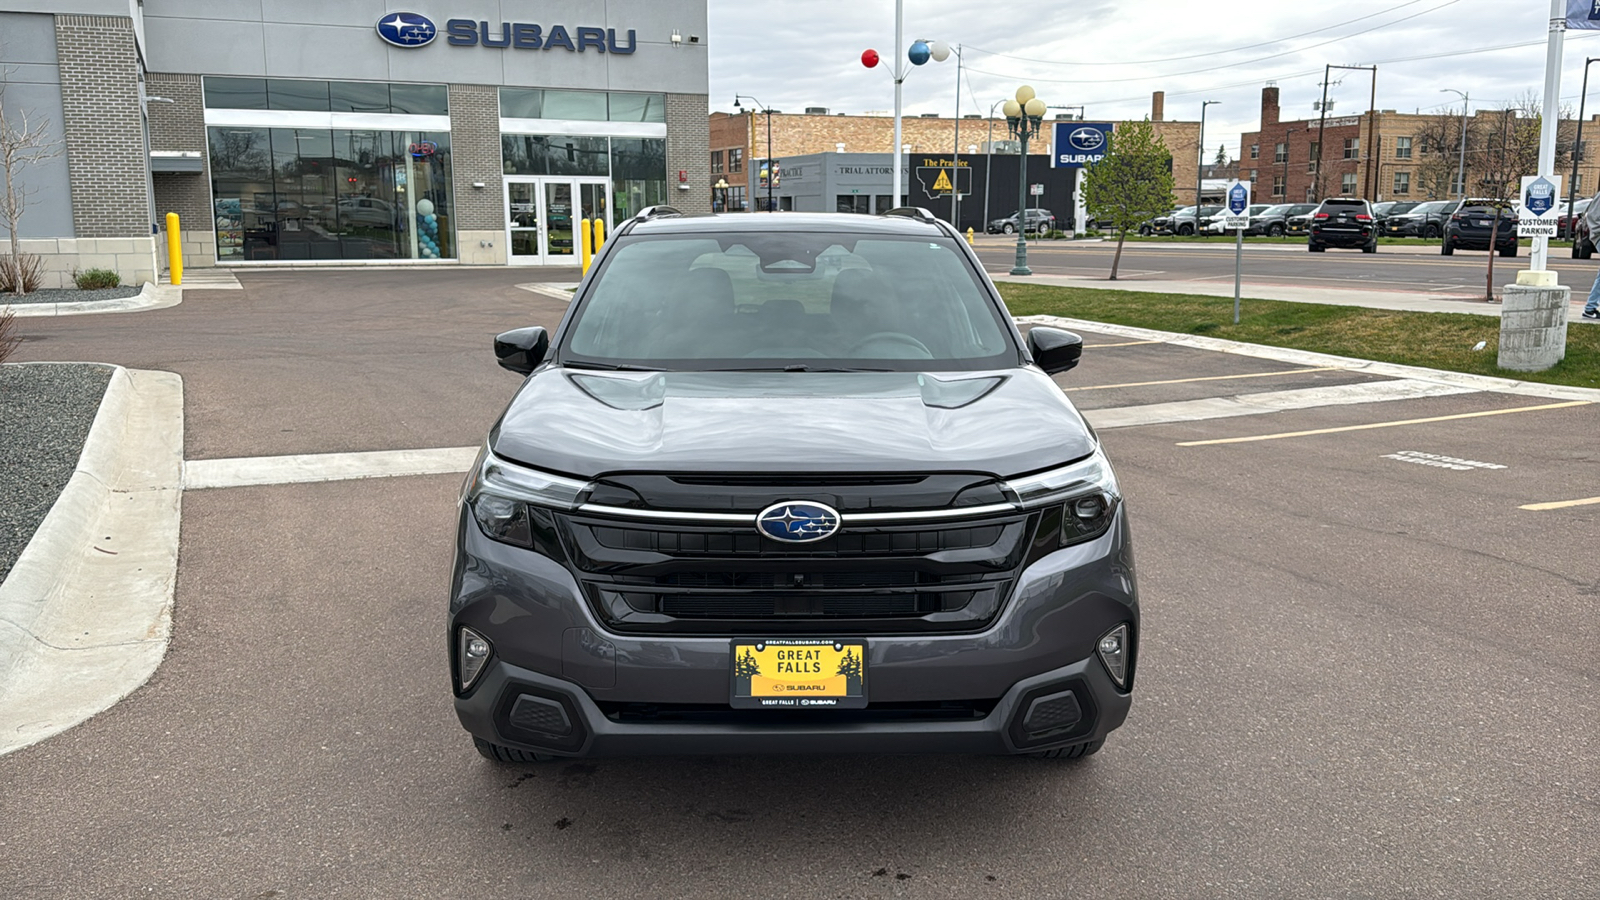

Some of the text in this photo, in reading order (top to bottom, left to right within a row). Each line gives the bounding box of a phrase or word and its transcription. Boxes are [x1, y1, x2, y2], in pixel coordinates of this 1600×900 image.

[447, 19, 636, 54] SUBARU
[923, 159, 968, 167] The Pracice
[1060, 154, 1105, 163] SUBAR
[865, 167, 909, 175] ATTORNYS
[777, 650, 821, 660] GREAT
[777, 662, 821, 673] FALLS
